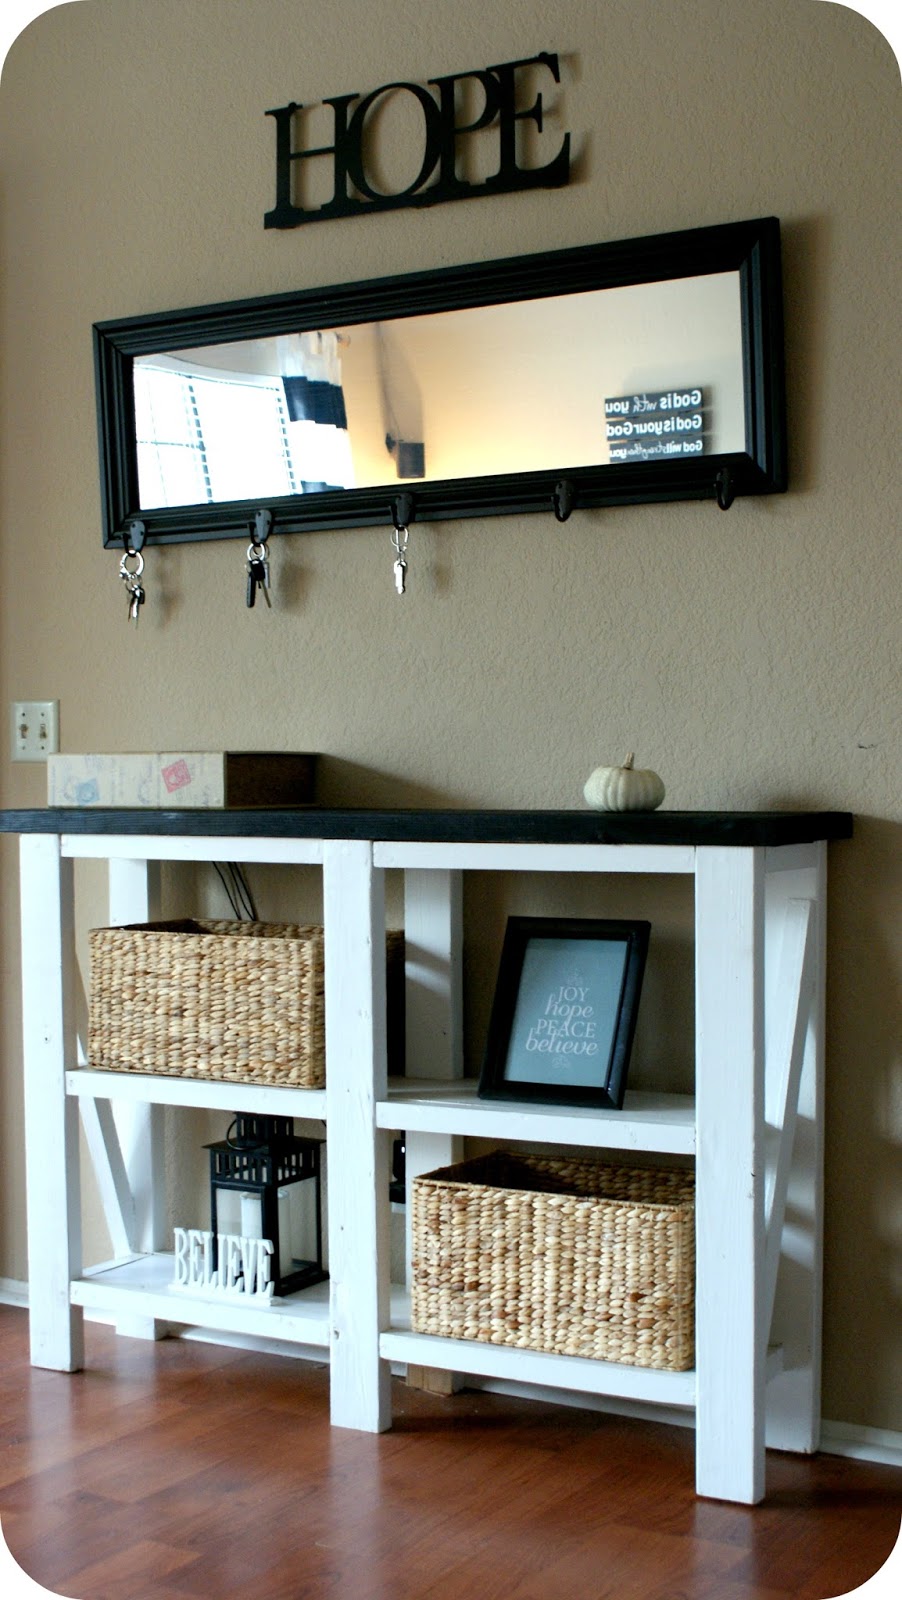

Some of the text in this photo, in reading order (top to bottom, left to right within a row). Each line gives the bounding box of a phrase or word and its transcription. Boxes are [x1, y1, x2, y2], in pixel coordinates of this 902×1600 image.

[264, 51, 570, 229] HOPE
[558, 986, 590, 1002] JOY
[545, 993, 594, 1026] hope
[525, 1028, 598, 1055] believe
[535, 1018, 597, 1038] PEACE
[173, 1227, 275, 1298] BELIEVE
